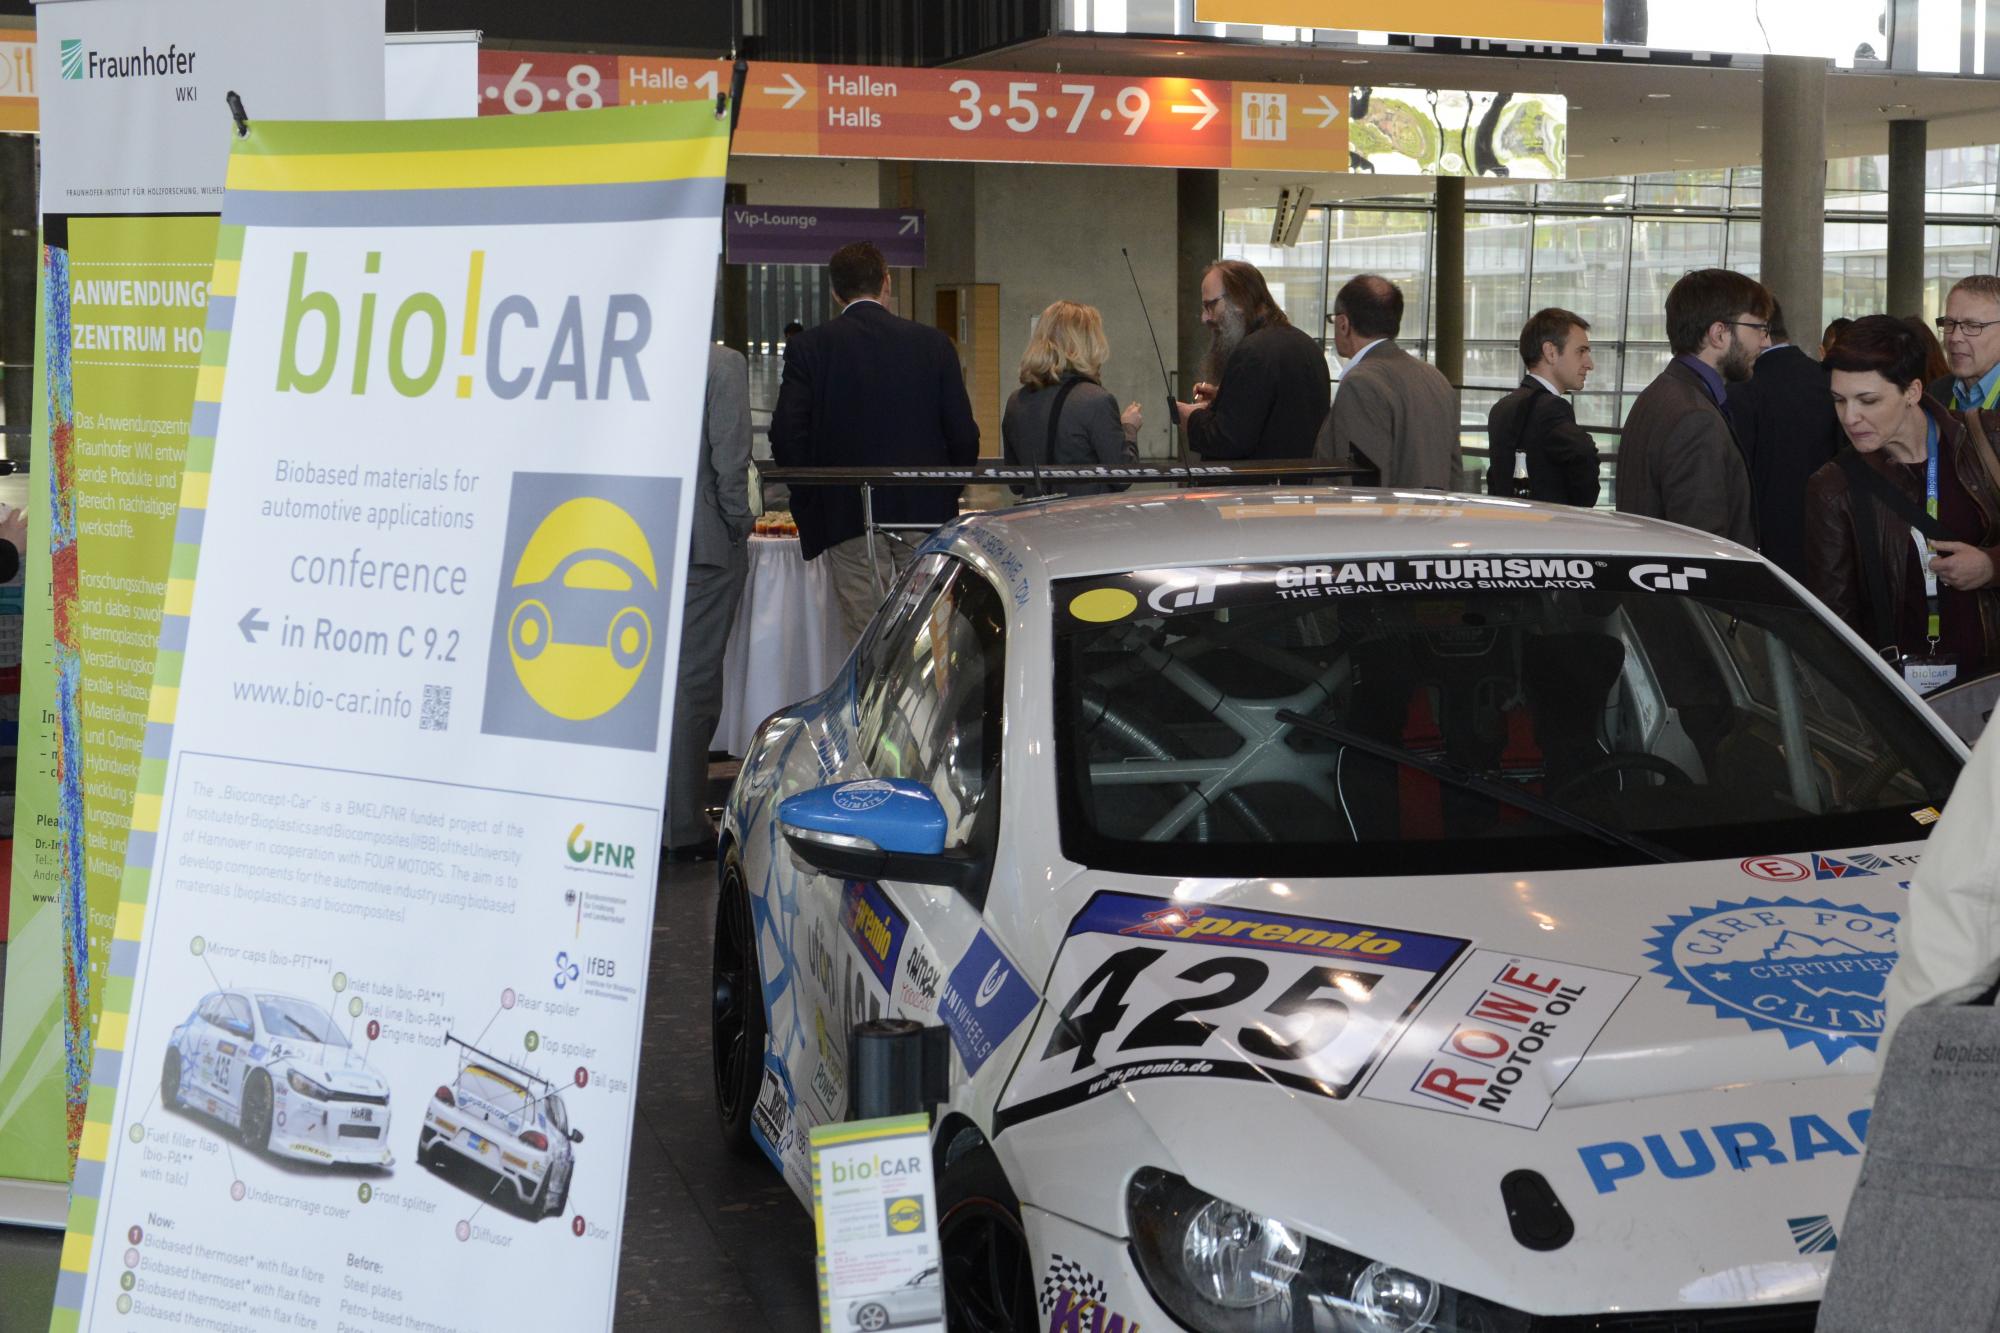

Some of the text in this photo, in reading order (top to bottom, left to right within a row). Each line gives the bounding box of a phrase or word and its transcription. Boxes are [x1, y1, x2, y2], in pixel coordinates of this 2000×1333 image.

[89, 44, 195, 78] Fraunhofer
[176, 87, 197, 101] WKI
[630, 68, 719, 99] Halle 1
[828, 75, 897, 97] Hallen
[828, 106, 882, 128] Halls
[67, 188, 130, 197] FRAUNHOFER-INSTITUT
[133, 188, 144, 196] FÜR
[148, 187, 199, 196] HOLZFORSCHUNG,
[734, 210, 817, 228] Vip-Lounge
[74, 324, 165, 352] ZENTRUM
[275, 250, 653, 401] bio!CAR
[76, 411, 94, 429] Das
[77, 439, 131, 459] Fraunhofer
[77, 467, 176, 488] sende Produkte und
[275, 459, 479, 492] Biobased materials for
[891, 465, 1237, 478] www.fourmotors.com
[78, 491, 176, 519] Bereich nachhaltiger
[261, 498, 474, 530] automotive applications
[79, 520, 134, 539] werkstoffe.
[290, 548, 467, 596] conference
[1276, 561, 1395, 589] GRAN
[1276, 577, 1595, 600] THE REAL DRIVING SIMULATOR
[282, 615, 460, 662] in Room C 9.2
[84, 678, 113, 695] textile
[233, 680, 412, 719] www.bio-car.info
[86, 730, 105, 745] und
[193, 781, 214, 797] The
[347, 801, 408, 822] BMEL/FNR
[411, 808, 444, 828] funded
[449, 817, 488, 834] project
[492, 821, 504, 834] of
[507, 822, 524, 838] the
[186, 805, 522, 868] Institute Bioplastics and Biocomposites University
[183, 830, 518, 889] of Hannover in cooperation with FOUR MOTORS. The aim to
[593, 841, 635, 870] FNR
[1757, 862, 1794, 876] E
[175, 878, 230, 896] materials
[300, 896, 320, 909] and
[178, 854, 515, 914] develop components for the automotive industry using biobased
[855, 898, 892, 960] premio
[1181, 911, 1402, 955] premio
[1687, 911, 1787, 957] CARE
[207, 941, 241, 958] Mirror
[242, 947, 267, 965] caps
[586, 956, 616, 978] IfBB
[347, 977, 393, 998] Inlet tube
[364, 1000, 402, 1023] fuel line
[517, 995, 580, 1017] Rear spoiler
[942, 982, 991, 1058] UNIWHEELS
[1041, 946, 1384, 1074] 425
[381, 1023, 442, 1048] Engine hood
[541, 1035, 597, 1059] Top spoiler
[1479, 986, 1586, 1112] MOTOR OIL
[590, 1070, 628, 1096] Tail gate
[1089, 1060, 1213, 1094] www.premio.de
[146, 1126, 220, 1155] Fuel filler flap
[139, 1167, 166, 1184] with
[831, 1153, 921, 1183] bio!CAR
[246, 1185, 351, 1220] Undercarriage cover
[372, 1187, 437, 1216] Front splitter
[148, 1211, 176, 1231] Now:
[587, 1221, 609, 1241] Door
[471, 1224, 513, 1248] Diffusor
[144, 1233, 193, 1256] Biobased
[256, 1258, 279, 1273] with
[281, 1261, 299, 1278] flax
[302, 1267, 325, 1284] fibre
[346, 1252, 383, 1274] Before:
[140, 1256, 190, 1280] Biobased
[253, 1279, 275, 1297] with
[277, 1285, 295, 1302] flax
[298, 1289, 321, 1308] fibre
[343, 1275, 402, 1302] Steel plates
[133, 1300, 182, 1324] Biobased
[136, 1278, 186, 1302] Biobased
[249, 1303, 272, 1320] with
[273, 1308, 292, 1324] flax
[294, 1311, 318, 1330] fibre
[339, 1299, 402, 1327] Petro-based
